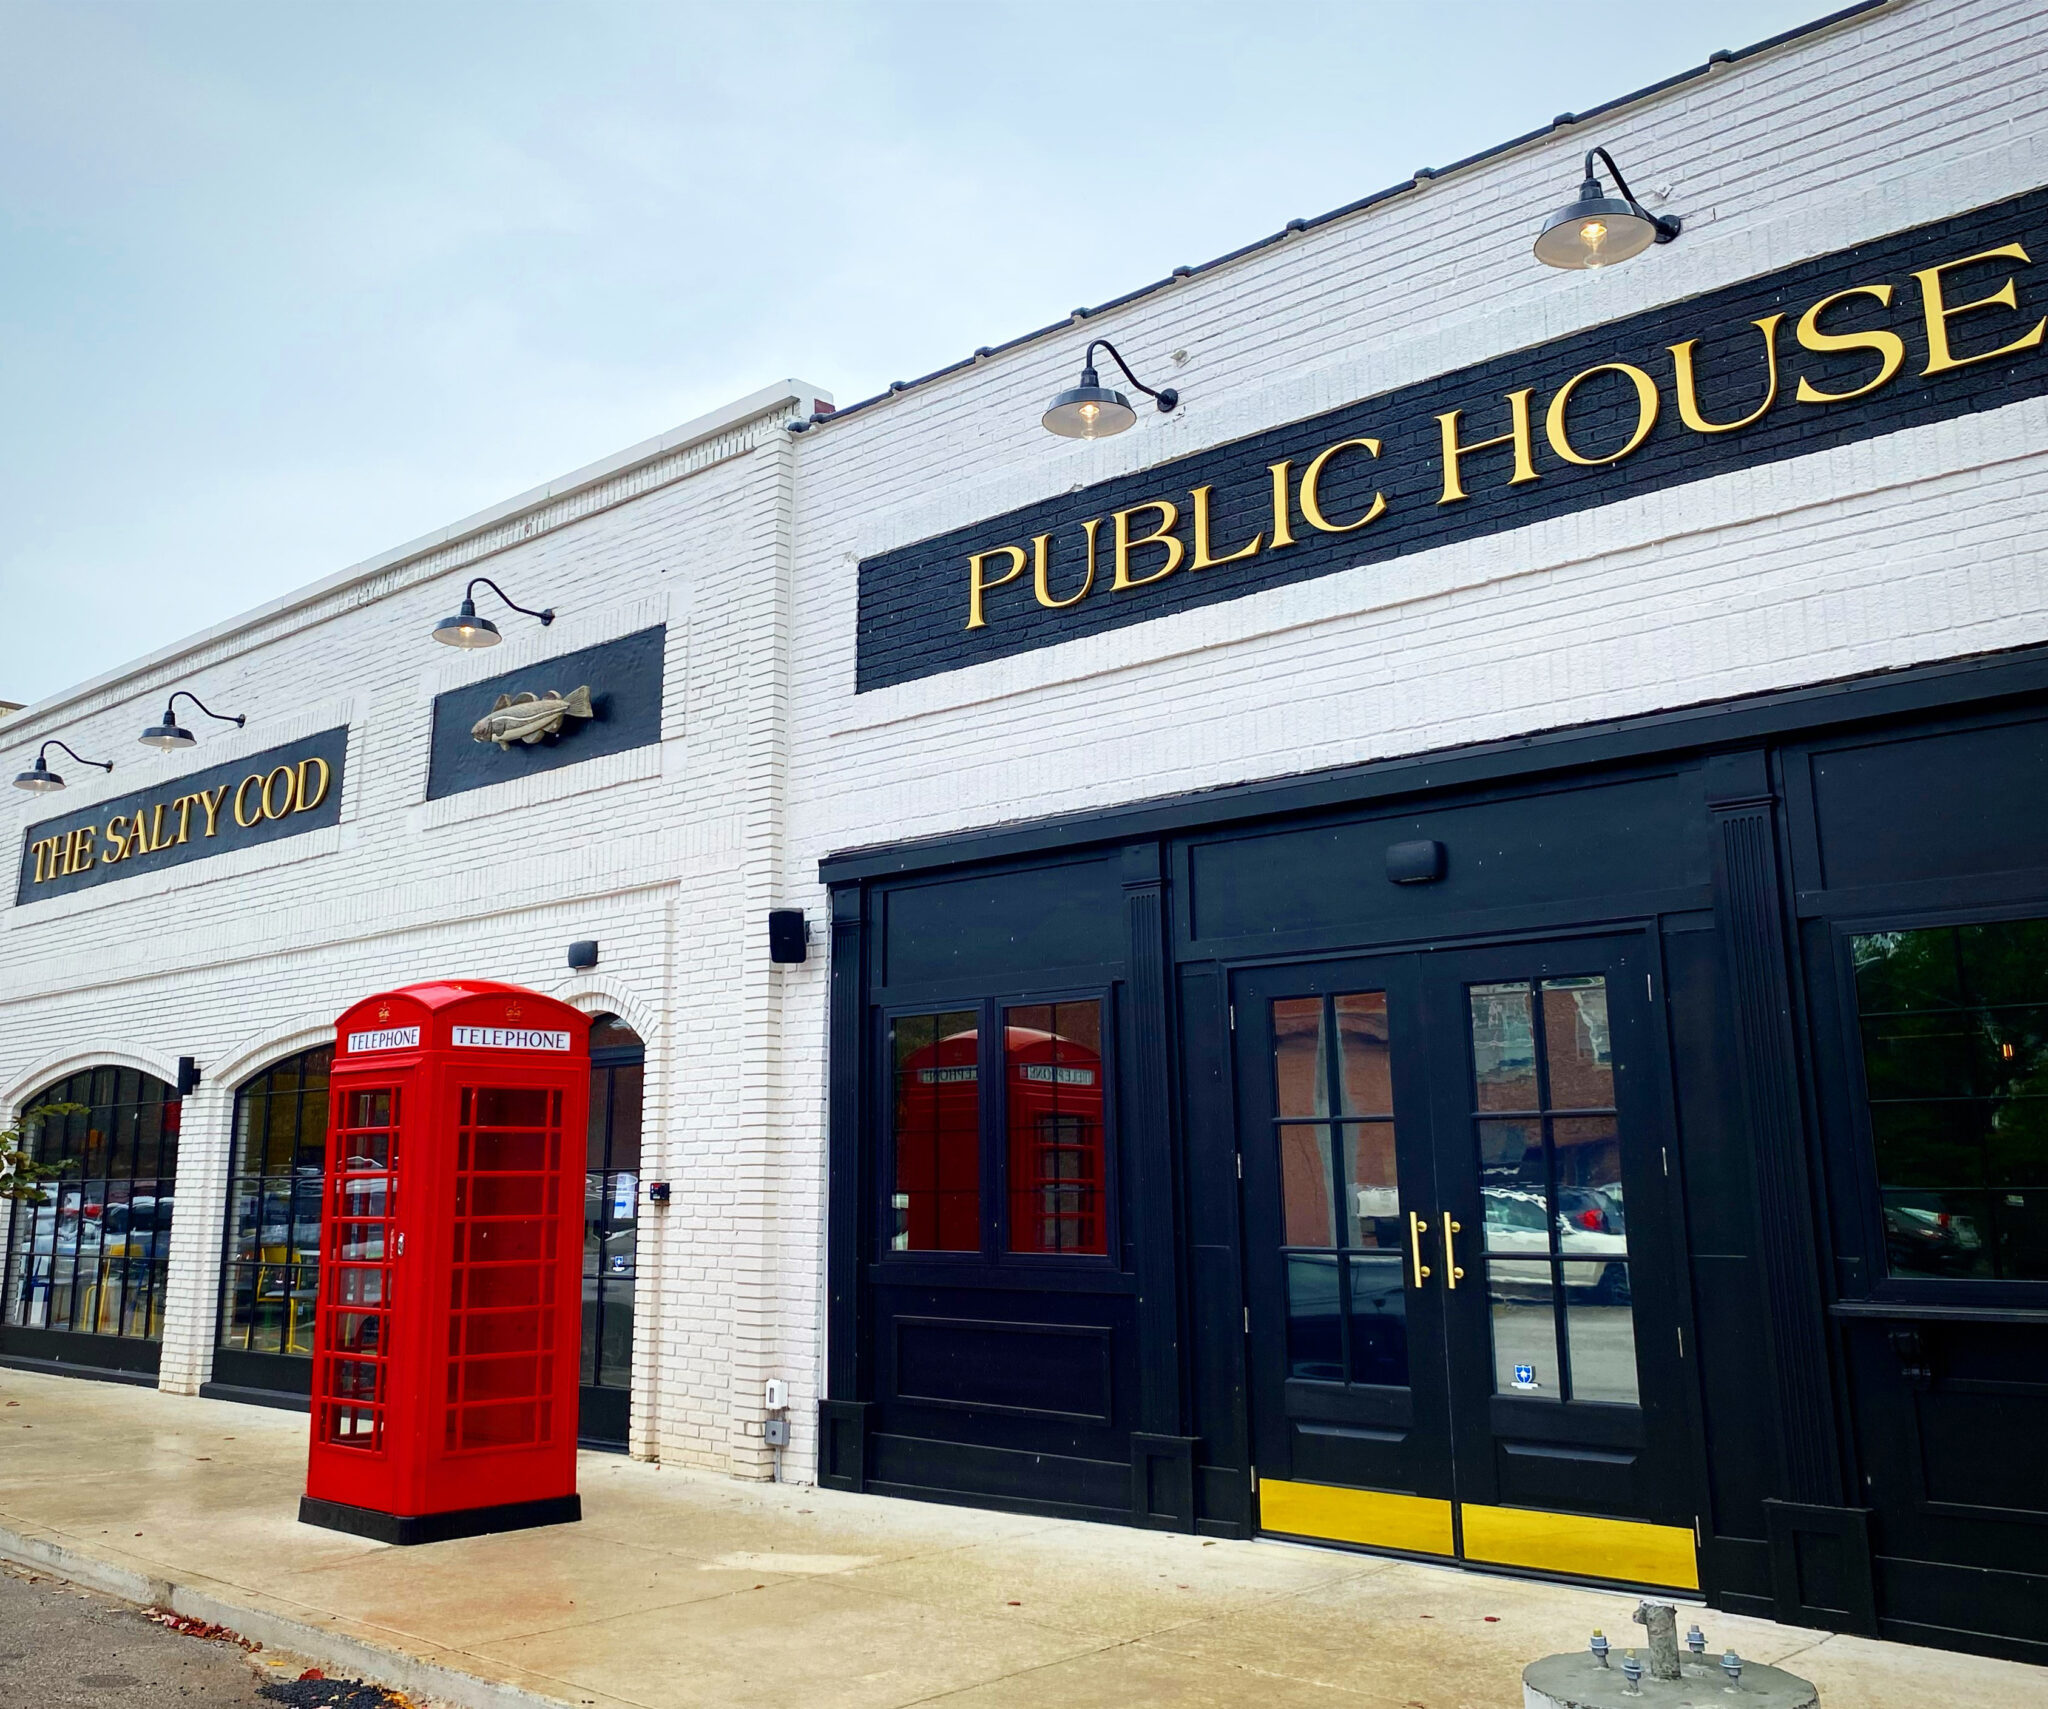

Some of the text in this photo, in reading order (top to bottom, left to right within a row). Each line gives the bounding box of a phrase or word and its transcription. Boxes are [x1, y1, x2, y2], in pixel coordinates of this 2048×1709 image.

[966, 242, 2047, 630] PUBLIC HOUSE
[31, 757, 330, 883] THE SALTY COD
[351, 1028, 418, 1050] TELEPHONE
[457, 1028, 566, 1049] TELEPHONE
